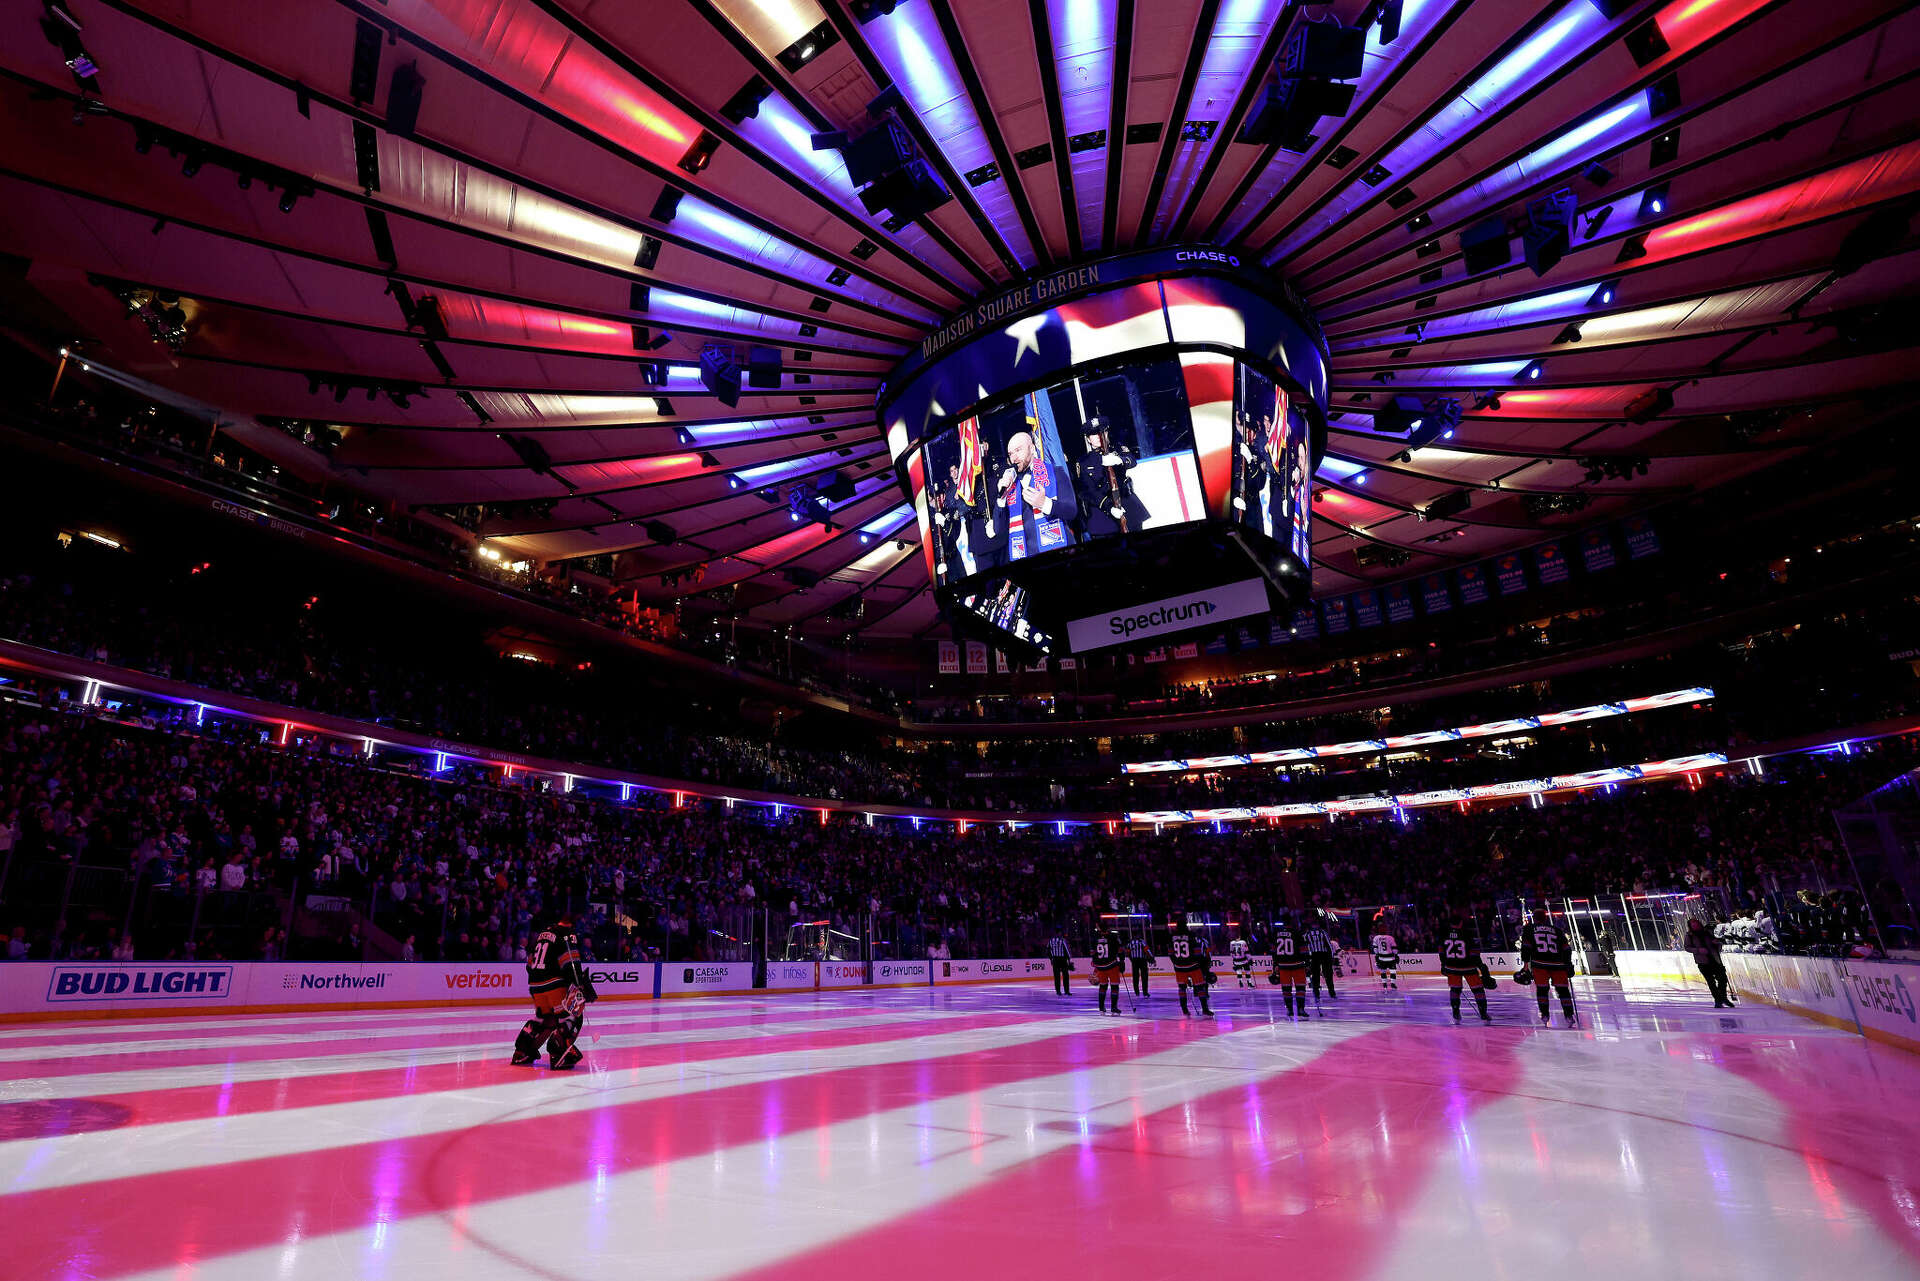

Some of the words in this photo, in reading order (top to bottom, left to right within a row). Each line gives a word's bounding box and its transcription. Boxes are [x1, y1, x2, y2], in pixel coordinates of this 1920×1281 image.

[1176, 251, 1228, 263] CHASE
[922, 312, 975, 361] MADISON
[978, 287, 1033, 325] SQUARE
[1036, 265, 1100, 299] GARDEN
[212, 500, 256, 521] CHASE
[270, 520, 305, 538] BRIDGE
[1109, 600, 1210, 637] Spectrum
[943, 650, 956, 663] 10
[970, 650, 983, 663] 12
[1097, 943, 1109, 959] 91
[1173, 941, 1190, 958] 93
[1276, 938, 1294, 955] 20
[1444, 939, 1466, 959] 23
[1533, 933, 1558, 953] 55
[531, 942, 550, 969] 31
[695, 967, 729, 977] CAESARS
[894, 966, 925, 976] HYUNDAI
[989, 964, 1013, 972] LEXUS
[1031, 963, 1046, 971] PEPSI
[55, 972, 130, 995] BUD
[133, 971, 226, 993] LIGHT
[300, 973, 386, 989] Northwell
[445, 970, 513, 988] verizon
[590, 971, 639, 983] EXUS
[1852, 974, 1903, 1015] CHASE
